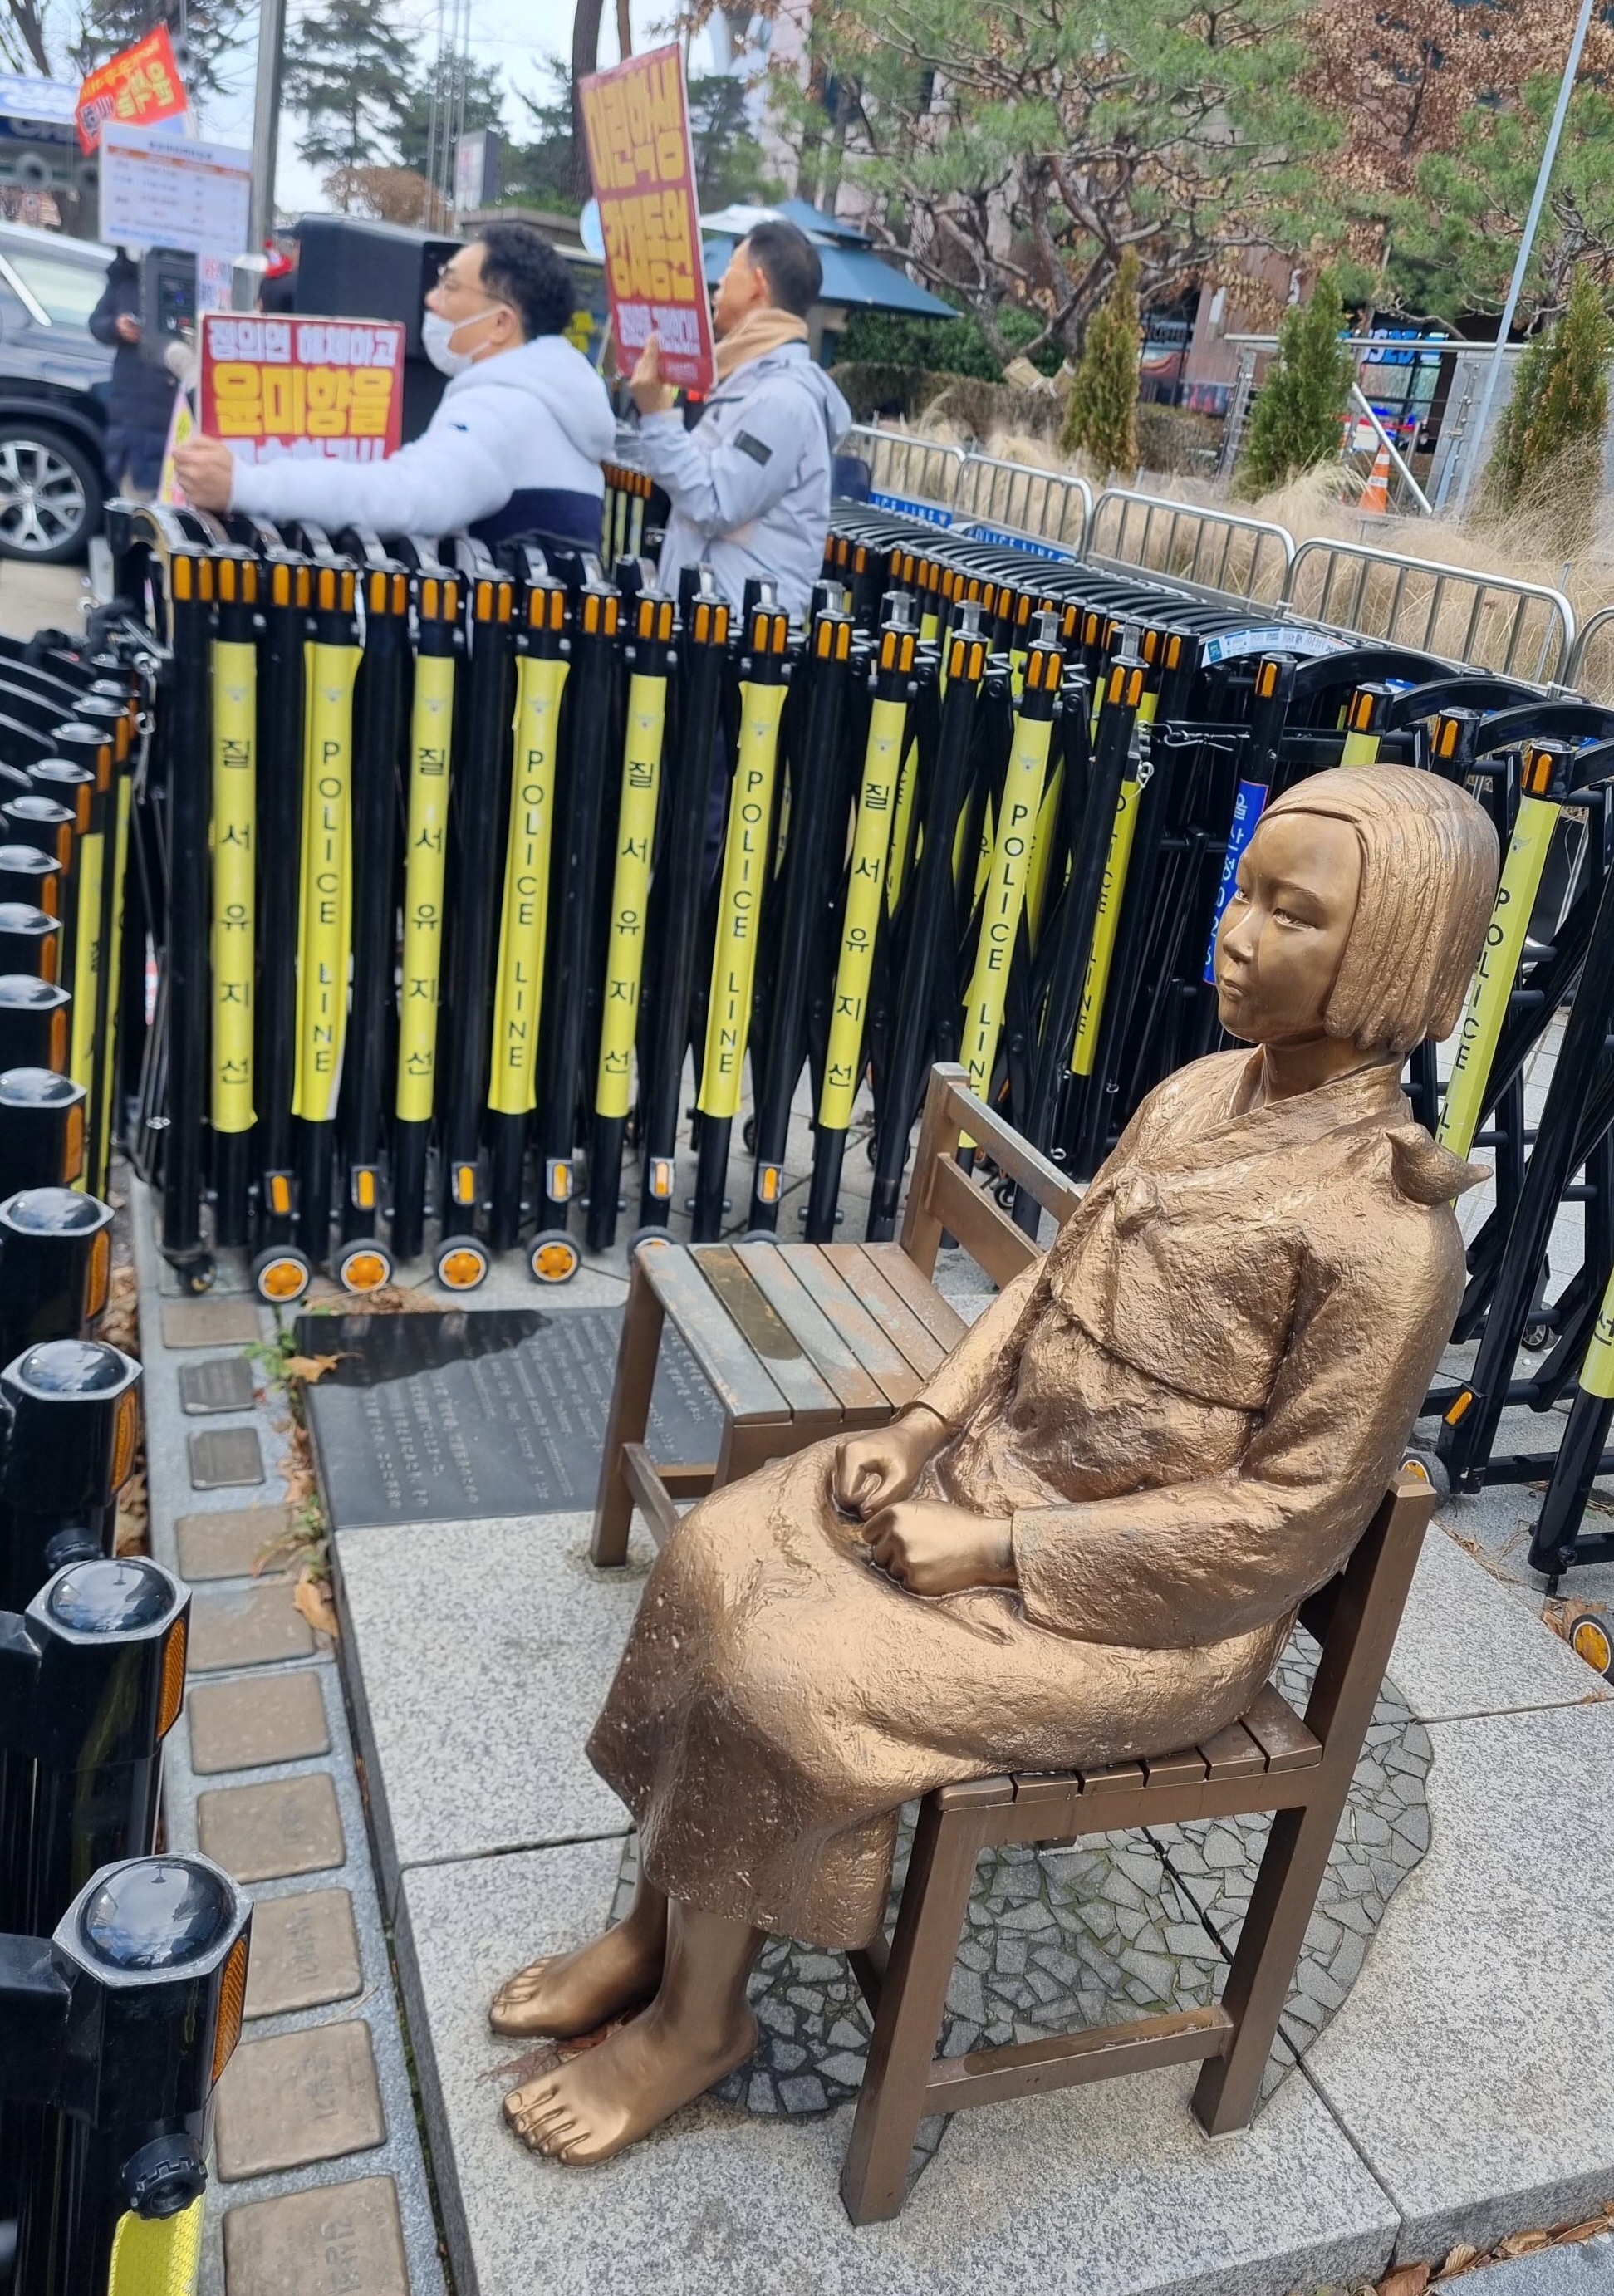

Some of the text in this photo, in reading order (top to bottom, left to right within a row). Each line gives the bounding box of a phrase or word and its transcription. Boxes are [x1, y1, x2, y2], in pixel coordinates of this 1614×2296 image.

[213, 363, 393, 436] 윤미향을
[219, 739, 249, 1083] 질서유지선
[313, 742, 341, 1072] POLICE LINE
[407, 748, 445, 1075] 질서유지선
[508, 751, 545, 1067] POLICE LINE
[605, 761, 652, 1073] 질서유지선
[719, 771, 763, 1074] POLICE LINE
[828, 783, 889, 1087] 질서유지선
[988, 804, 1028, 970] POLICE
[1455, 887, 1510, 1071] POLICE
